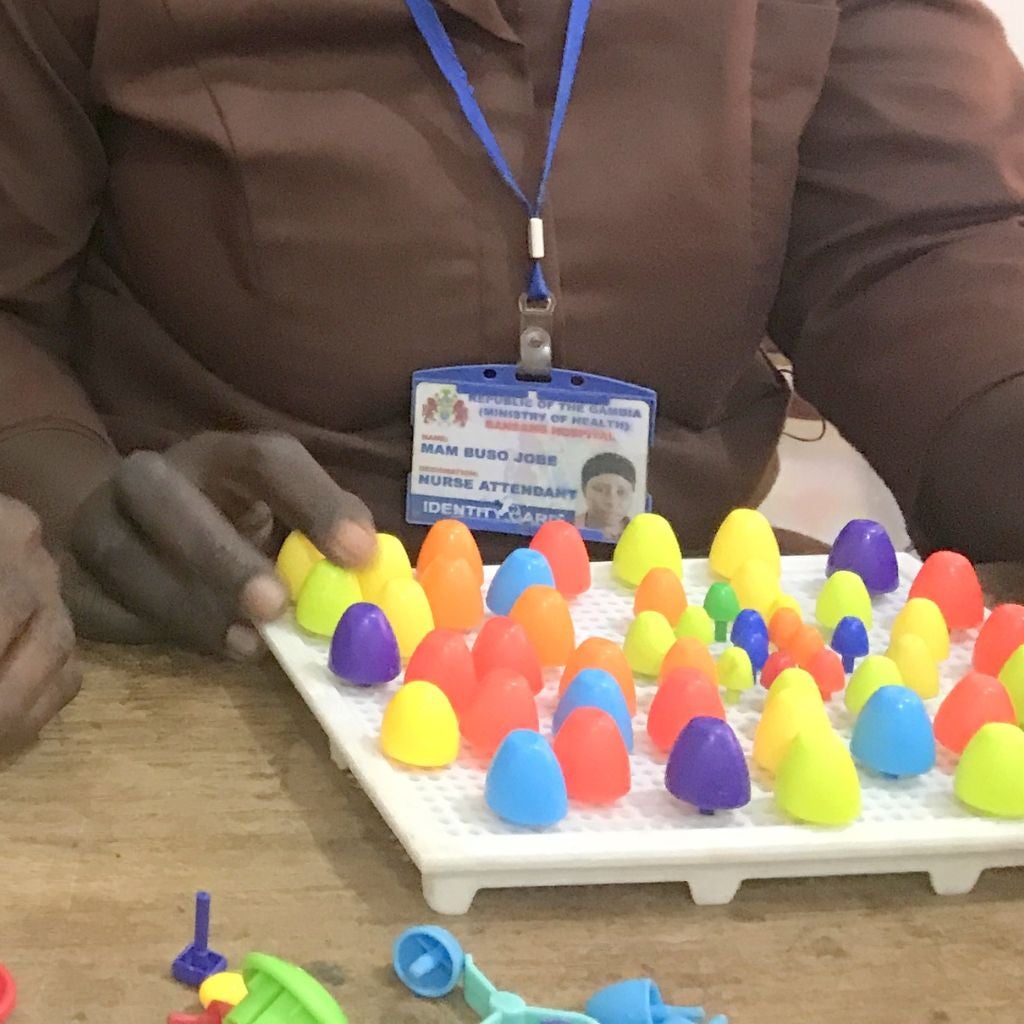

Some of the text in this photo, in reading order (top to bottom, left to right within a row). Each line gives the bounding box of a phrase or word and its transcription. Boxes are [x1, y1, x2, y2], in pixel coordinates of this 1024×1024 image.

[537, 400, 553, 410] OF
[560, 402, 588, 413] THE
[589, 404, 642, 418] GAMBIA
[551, 414, 566, 424] OF
[420, 442, 458, 457] MAM
[418, 474, 578, 500] NURSE ATTENDANT
